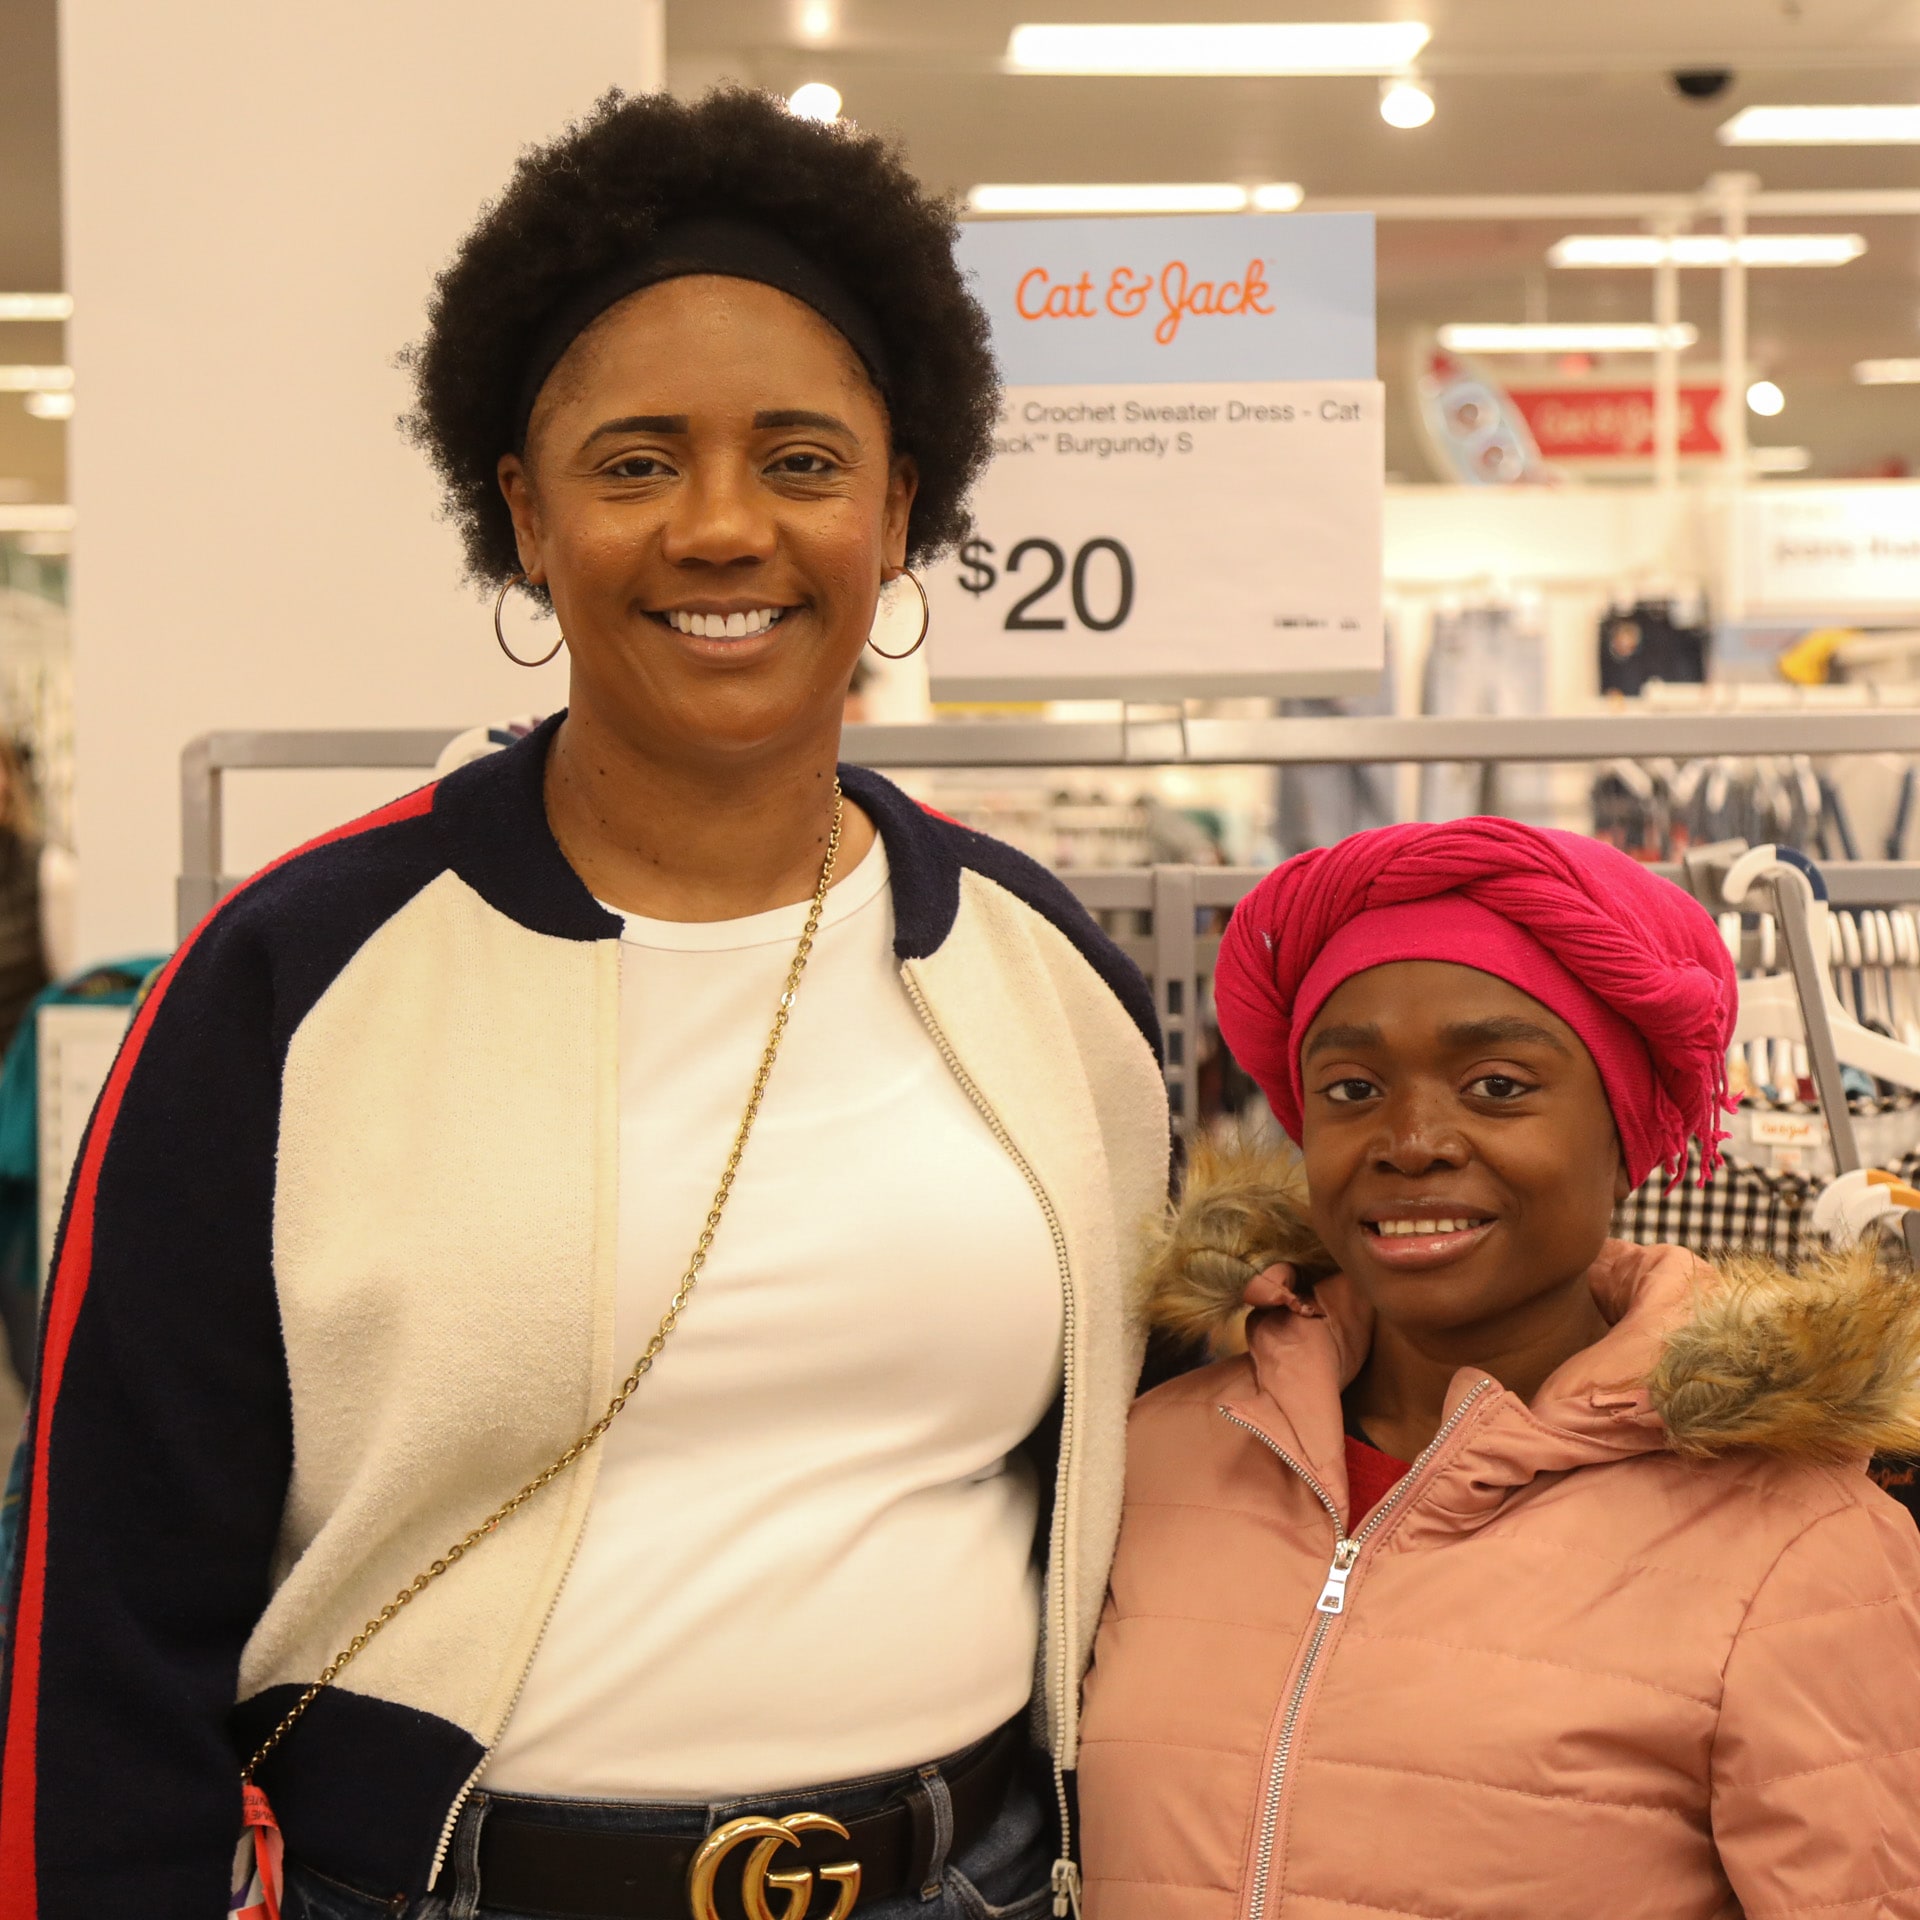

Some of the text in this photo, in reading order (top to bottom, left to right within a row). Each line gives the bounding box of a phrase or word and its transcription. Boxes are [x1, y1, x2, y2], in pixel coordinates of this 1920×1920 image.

[1014, 257, 1277, 346] Cat & Jack
[1023, 400, 1117, 423] Crochet
[1124, 400, 1219, 423] Sweater
[1227, 399, 1296, 422] Dress
[1320, 399, 1361, 423] Cat
[1056, 431, 1169, 459] Burgundy
[1177, 431, 1194, 454] S
[957, 534, 1136, 632] $20
